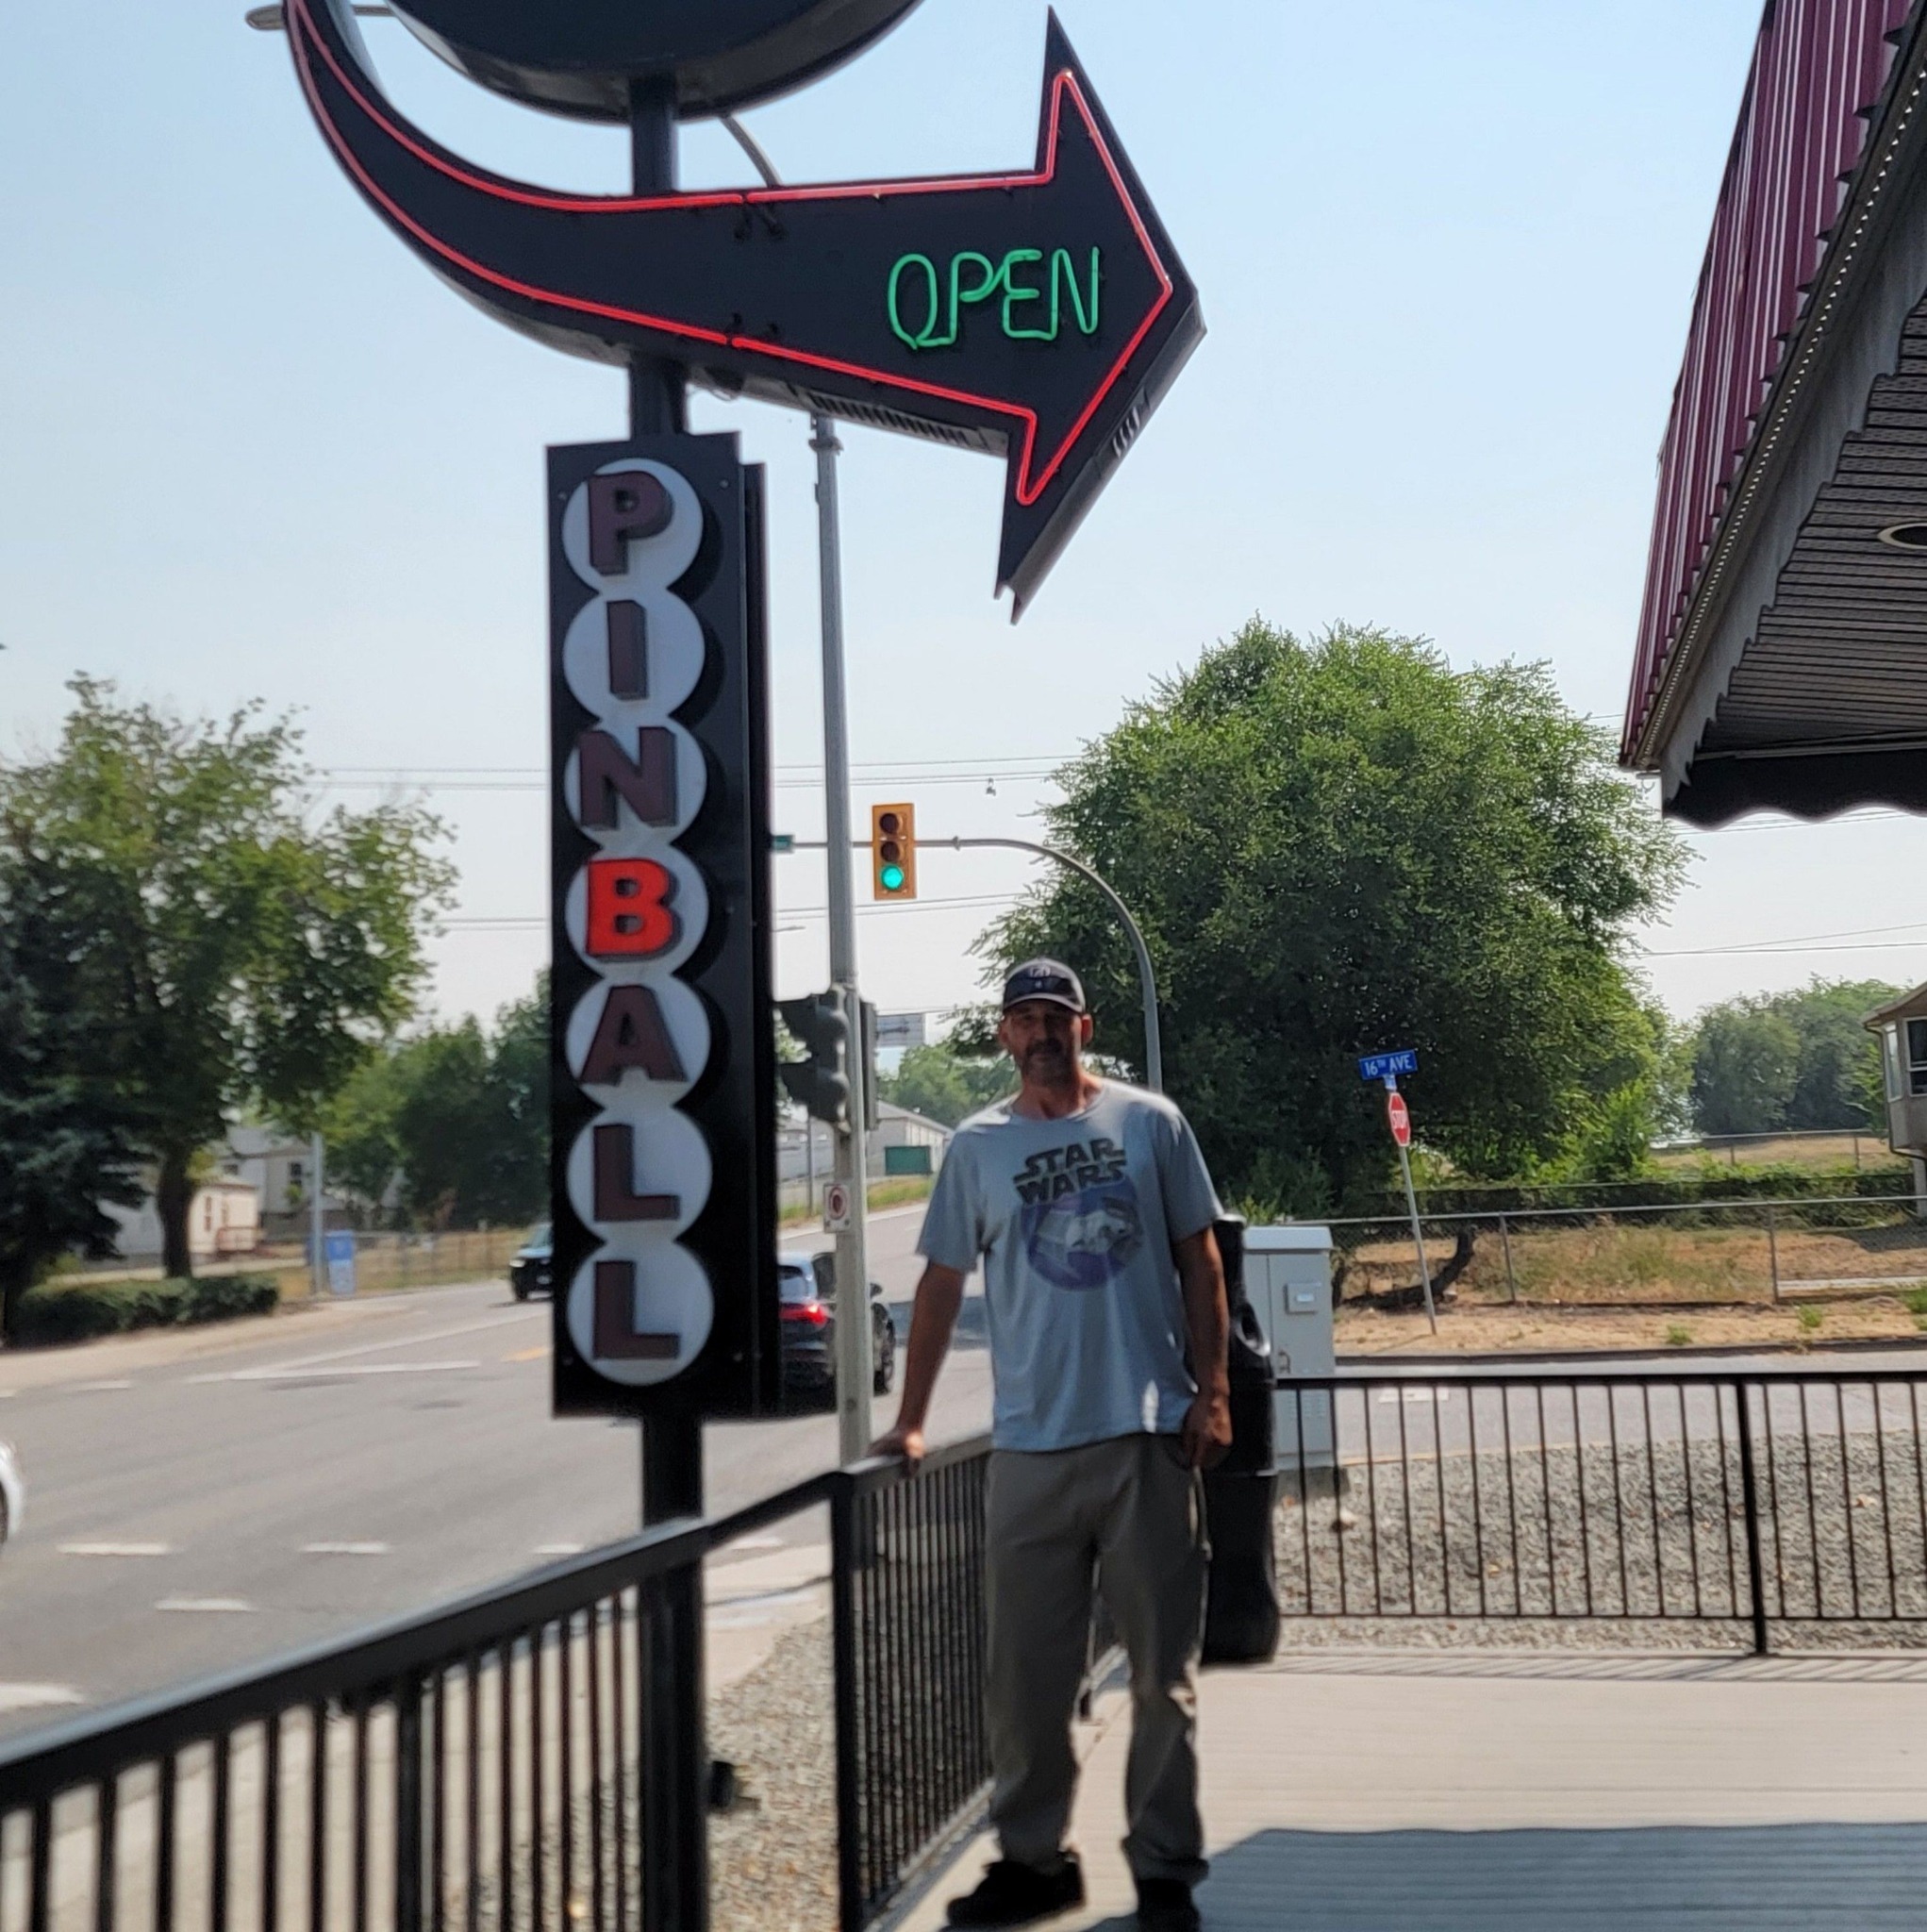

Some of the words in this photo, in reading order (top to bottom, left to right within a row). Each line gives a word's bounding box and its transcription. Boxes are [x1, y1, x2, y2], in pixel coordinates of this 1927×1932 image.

[888, 246, 1100, 350] OPEN
[576, 471, 689, 1360] PINBALL
[1389, 1054, 1413, 1073] AVE
[1013, 1138, 1126, 1184] STAR
[1016, 1159, 1126, 1205] WARS
